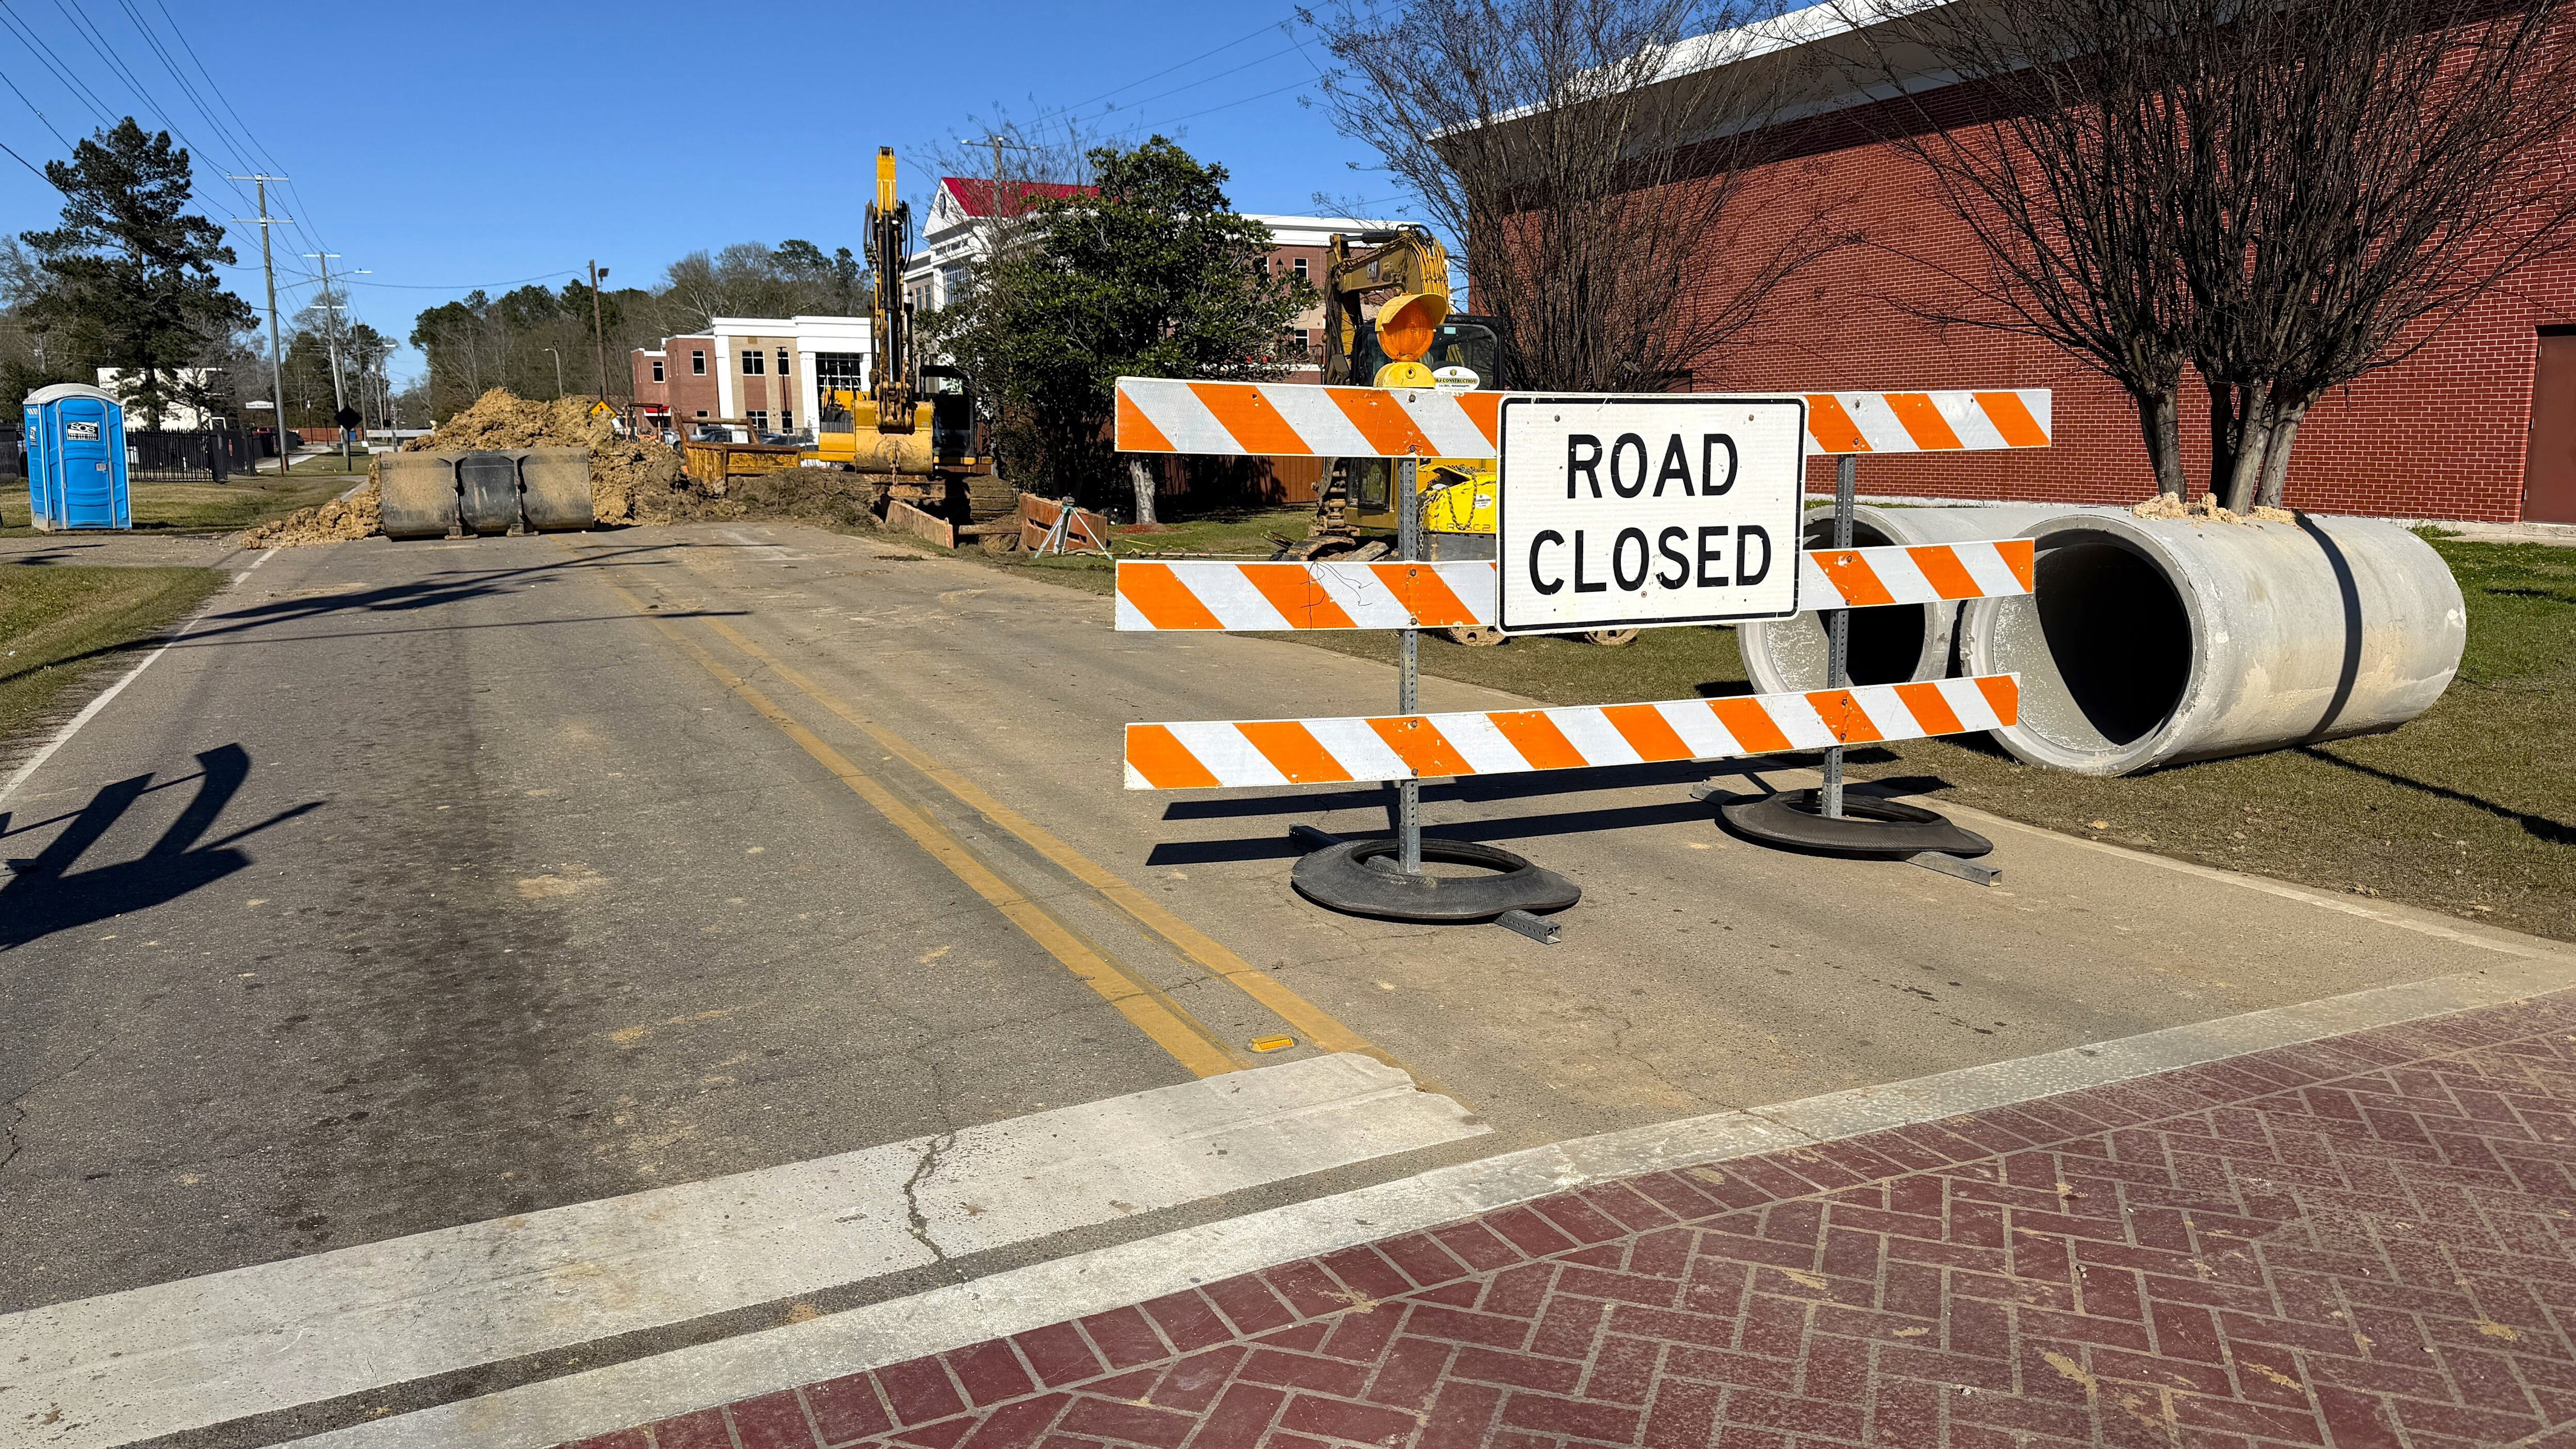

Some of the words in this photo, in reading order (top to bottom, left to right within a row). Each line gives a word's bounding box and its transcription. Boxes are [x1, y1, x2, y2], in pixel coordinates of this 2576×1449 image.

[1368, 260, 1378, 279] CAT
[70, 423, 96, 433] SOS
[1567, 433, 1738, 499] ROAD
[1529, 525, 1772, 595] CLOSED
